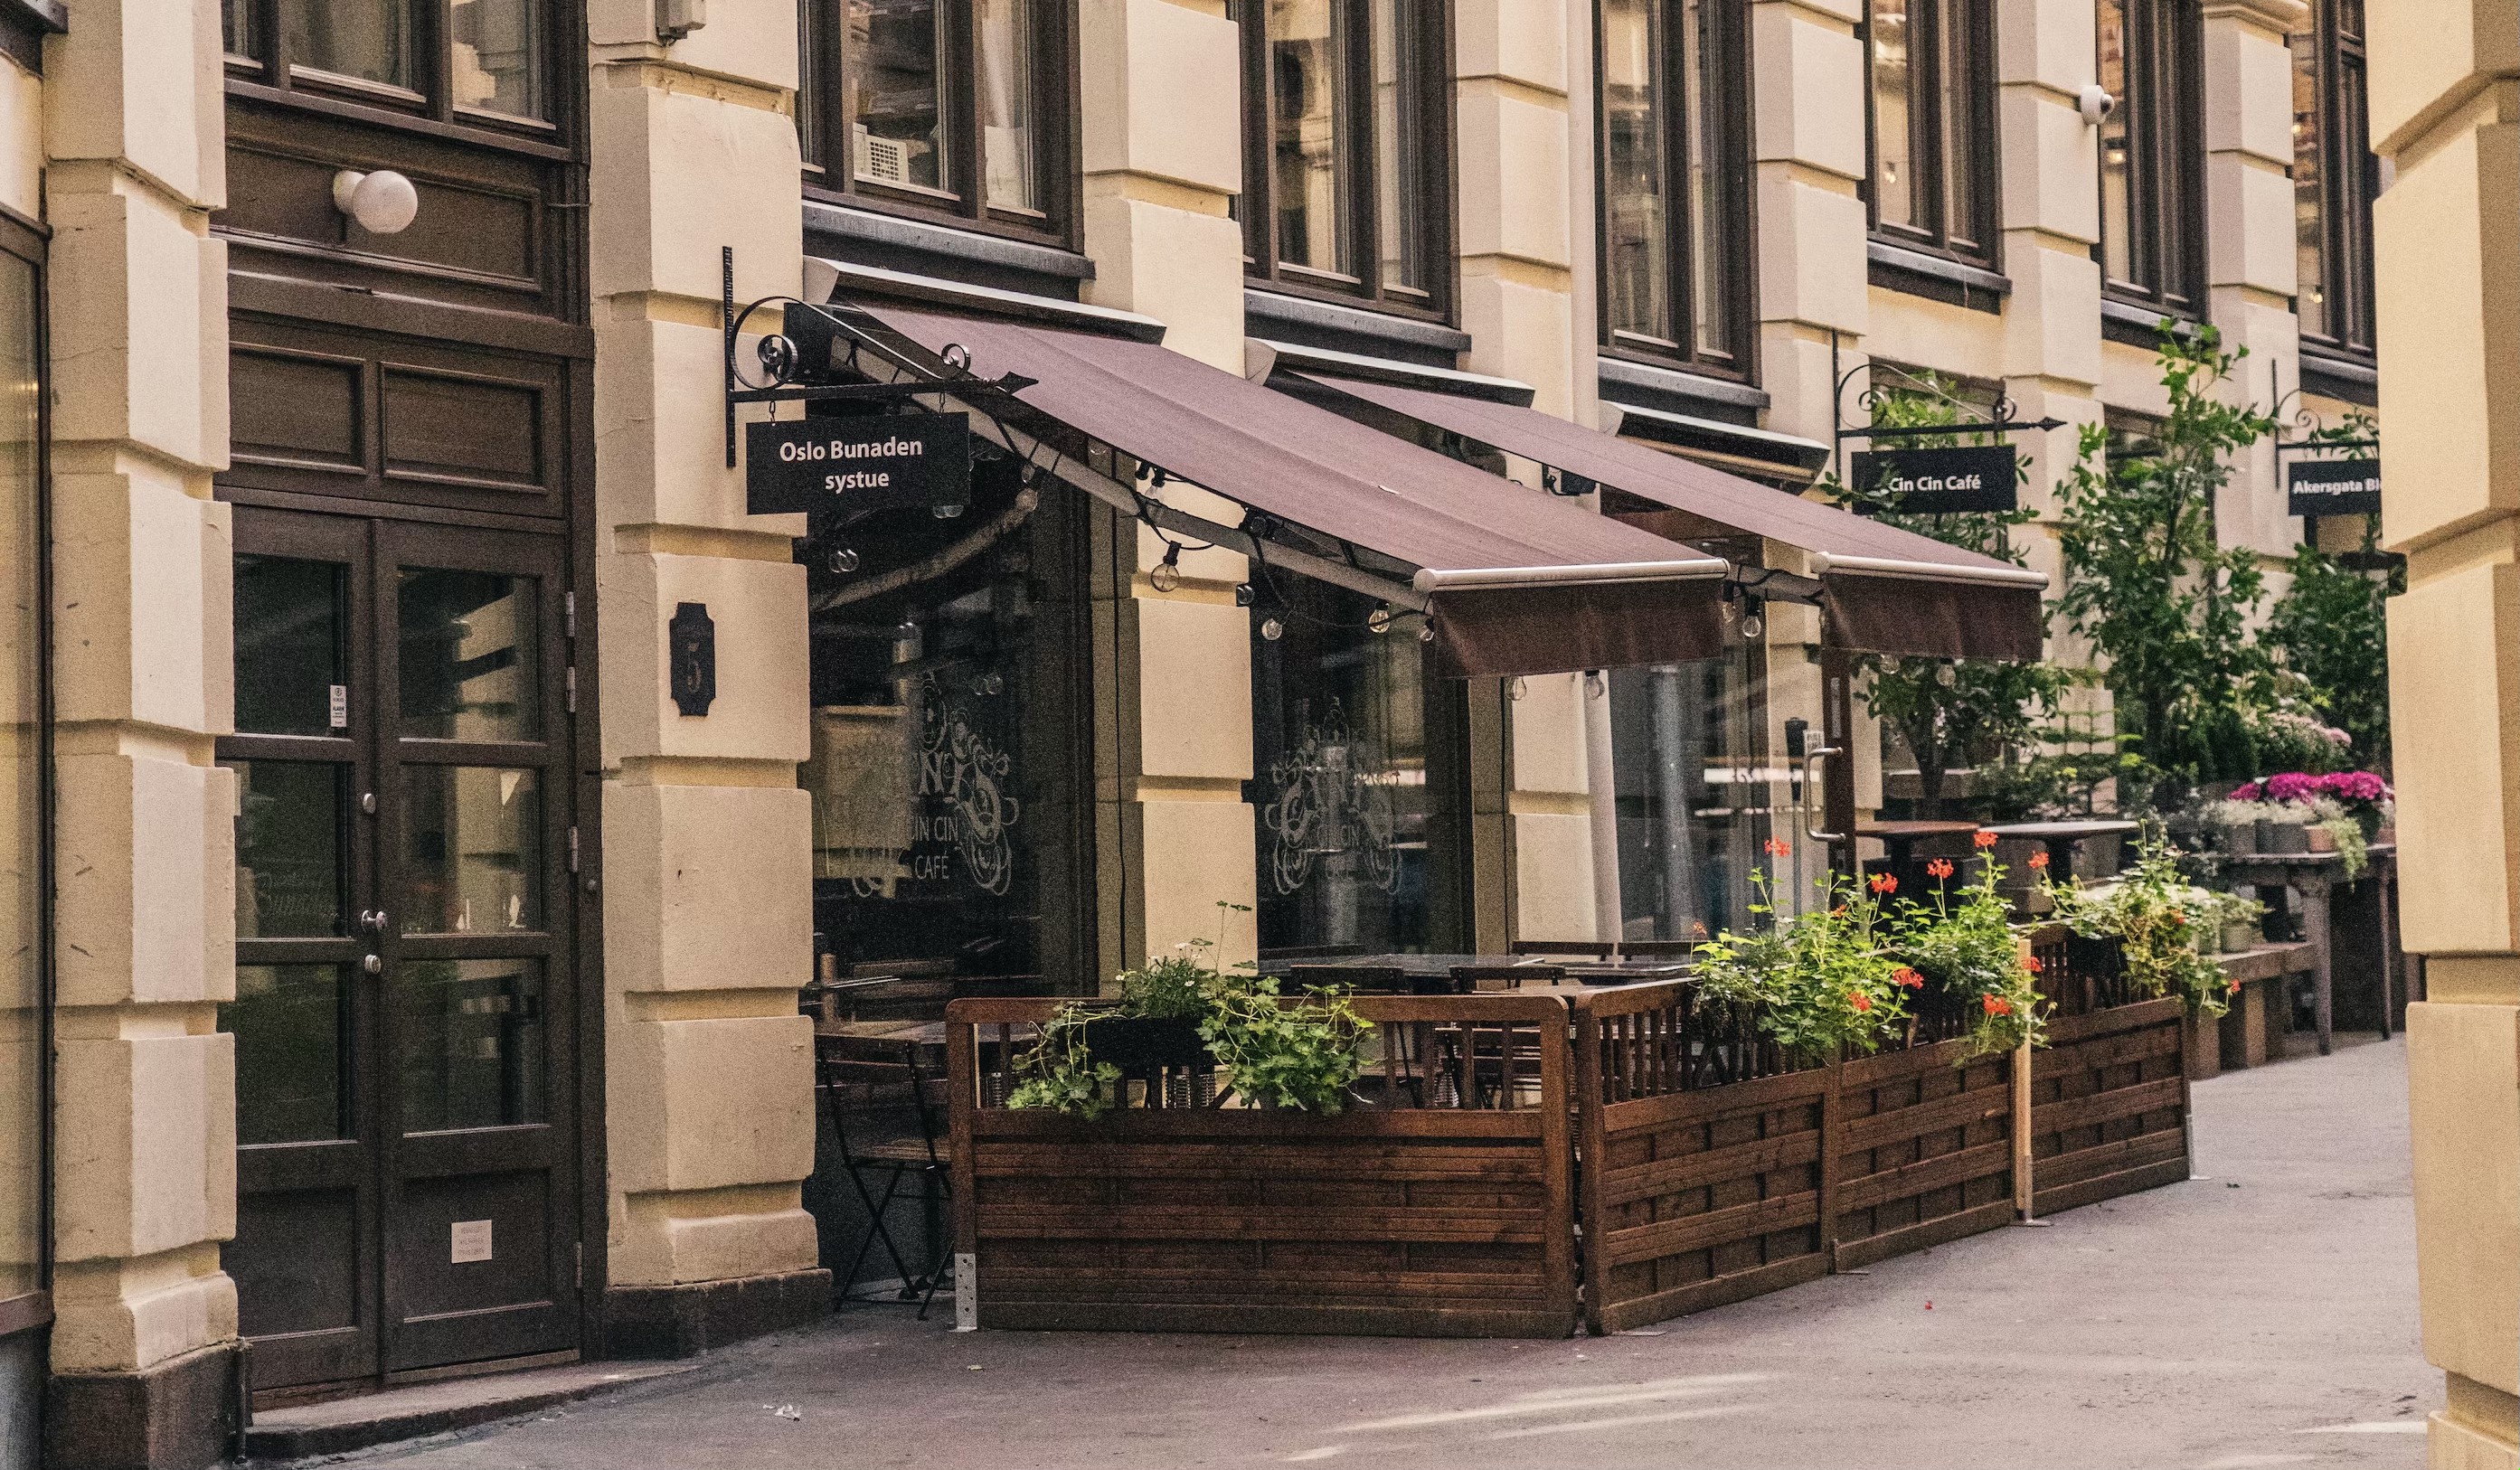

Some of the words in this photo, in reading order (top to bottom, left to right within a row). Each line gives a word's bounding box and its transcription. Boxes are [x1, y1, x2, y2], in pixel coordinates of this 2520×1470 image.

[779, 440, 826, 462] Oslo
[830, 436, 922, 459] Bunaden
[825, 471, 890, 495] systue
[1889, 476, 1914, 493] Cin
[1916, 476, 1943, 492] Cin
[1945, 474, 1982, 491] Café
[2293, 479, 2364, 495] Akersgata
[934, 815, 958, 842] CIN
[914, 848, 950, 880] CAFÉ
